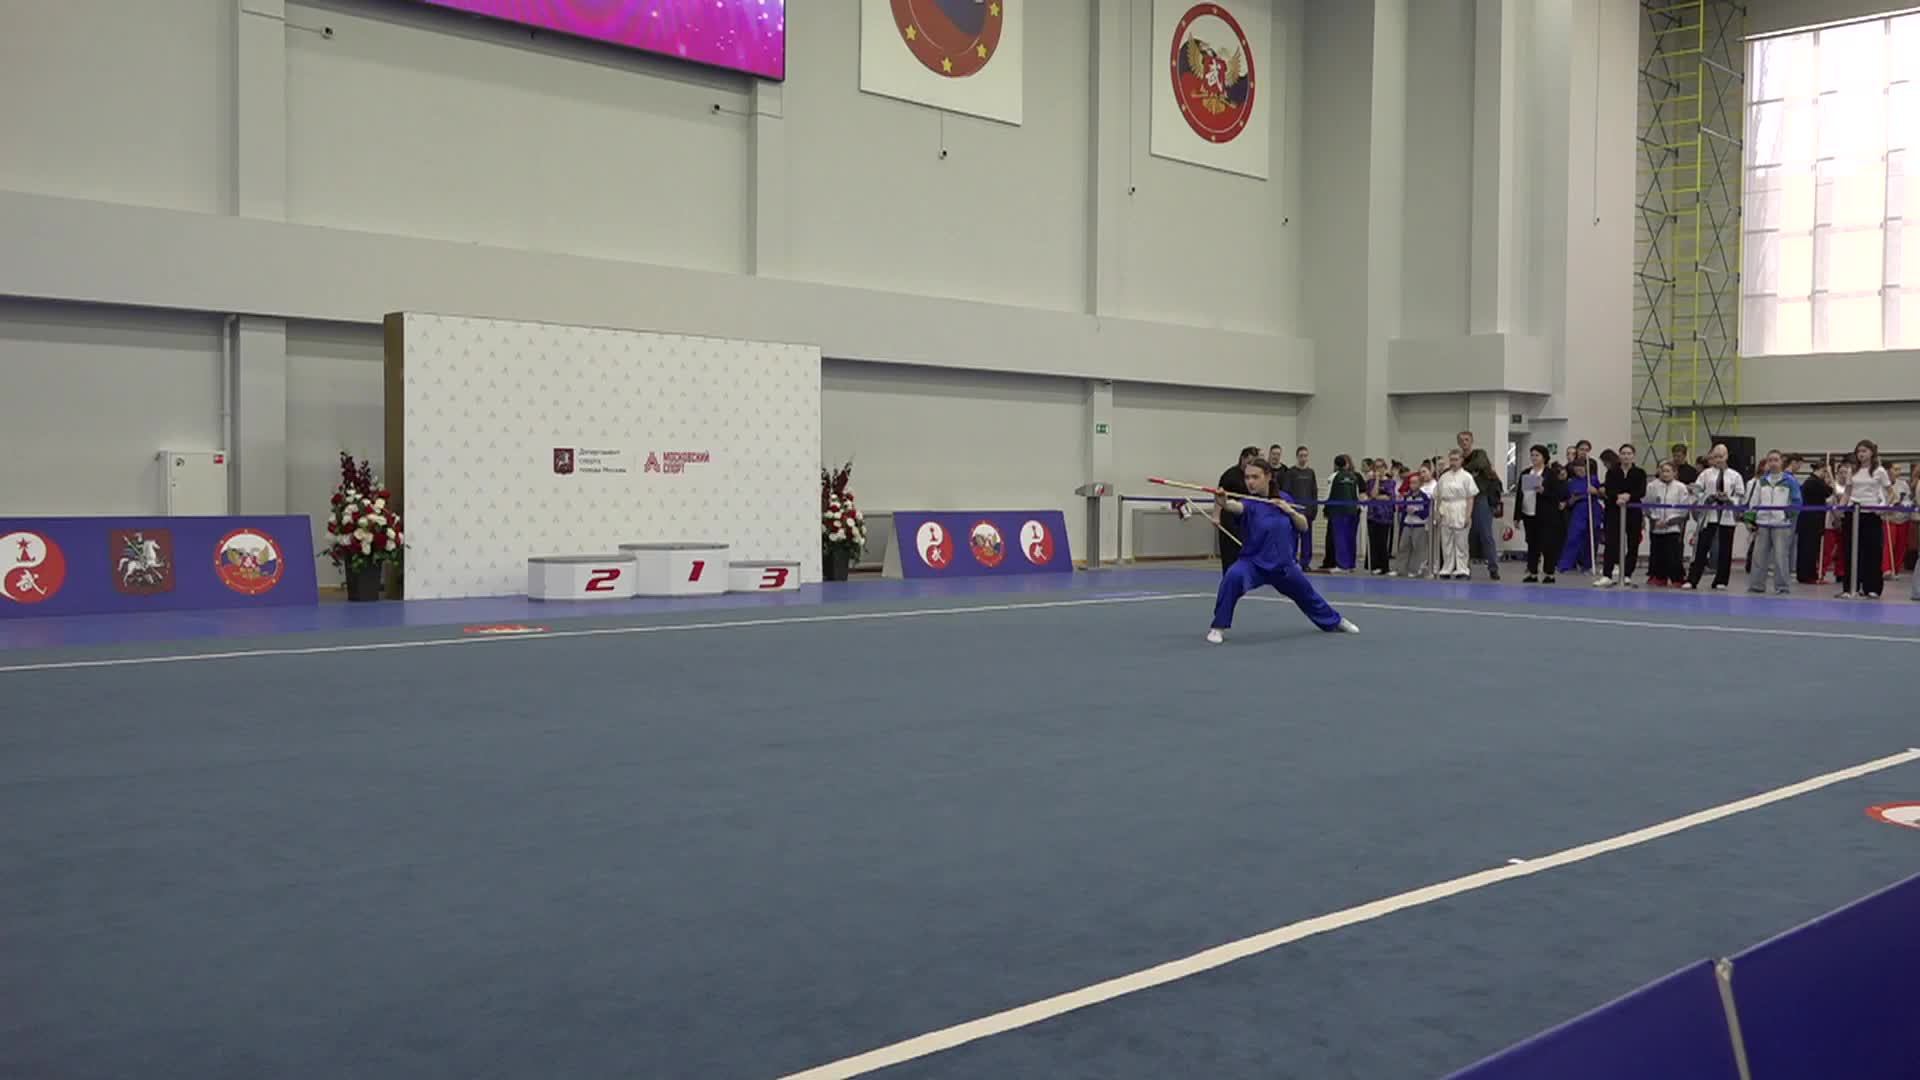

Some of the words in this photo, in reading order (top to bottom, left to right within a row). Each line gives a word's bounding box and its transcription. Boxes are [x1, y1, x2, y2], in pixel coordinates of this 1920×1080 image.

[663, 449, 710, 463] МОСКОВСКИЙ
[663, 463, 685, 474] СПОРТ
[585, 568, 621, 592] 2
[688, 561, 705, 582] 1
[759, 568, 789, 589] 3
